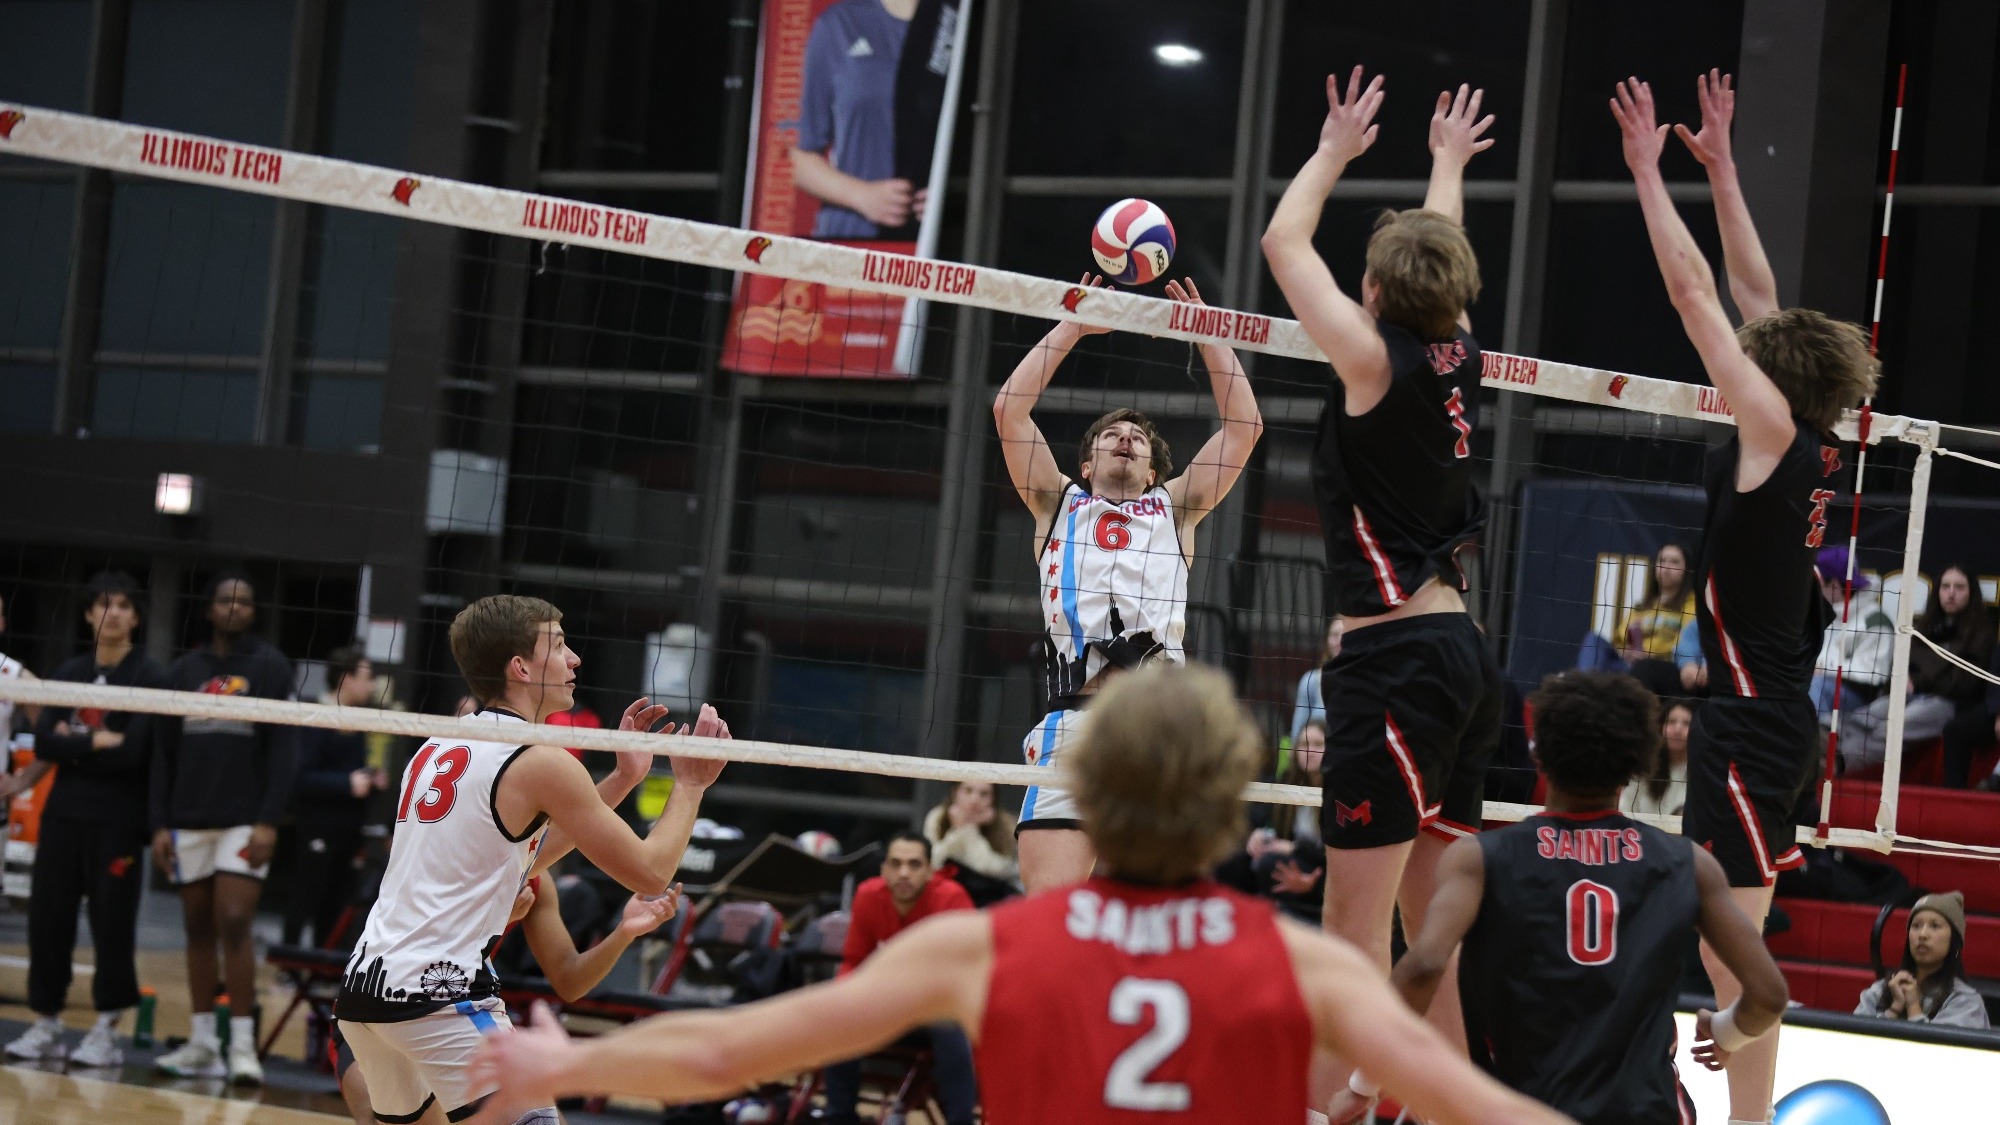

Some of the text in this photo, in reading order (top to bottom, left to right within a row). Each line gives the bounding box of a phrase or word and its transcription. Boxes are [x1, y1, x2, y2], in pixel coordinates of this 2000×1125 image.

[140, 133, 283, 185] ILLINOIS TECH
[522, 199, 649, 245] ILLINOIS TECH
[862, 253, 977, 296] ILLINOIS TECH
[1168, 303, 1271, 344] ILLINOIS TECH
[1504, 356, 1539, 385] TECH
[1093, 509, 1132, 552] 6
[397, 743, 472, 824] 13
[1536, 826, 1644, 866] SAINTS
[1066, 889, 1235, 955] SAINTS
[1566, 879, 1620, 966] 0
[1104, 976, 1191, 1111] 2
